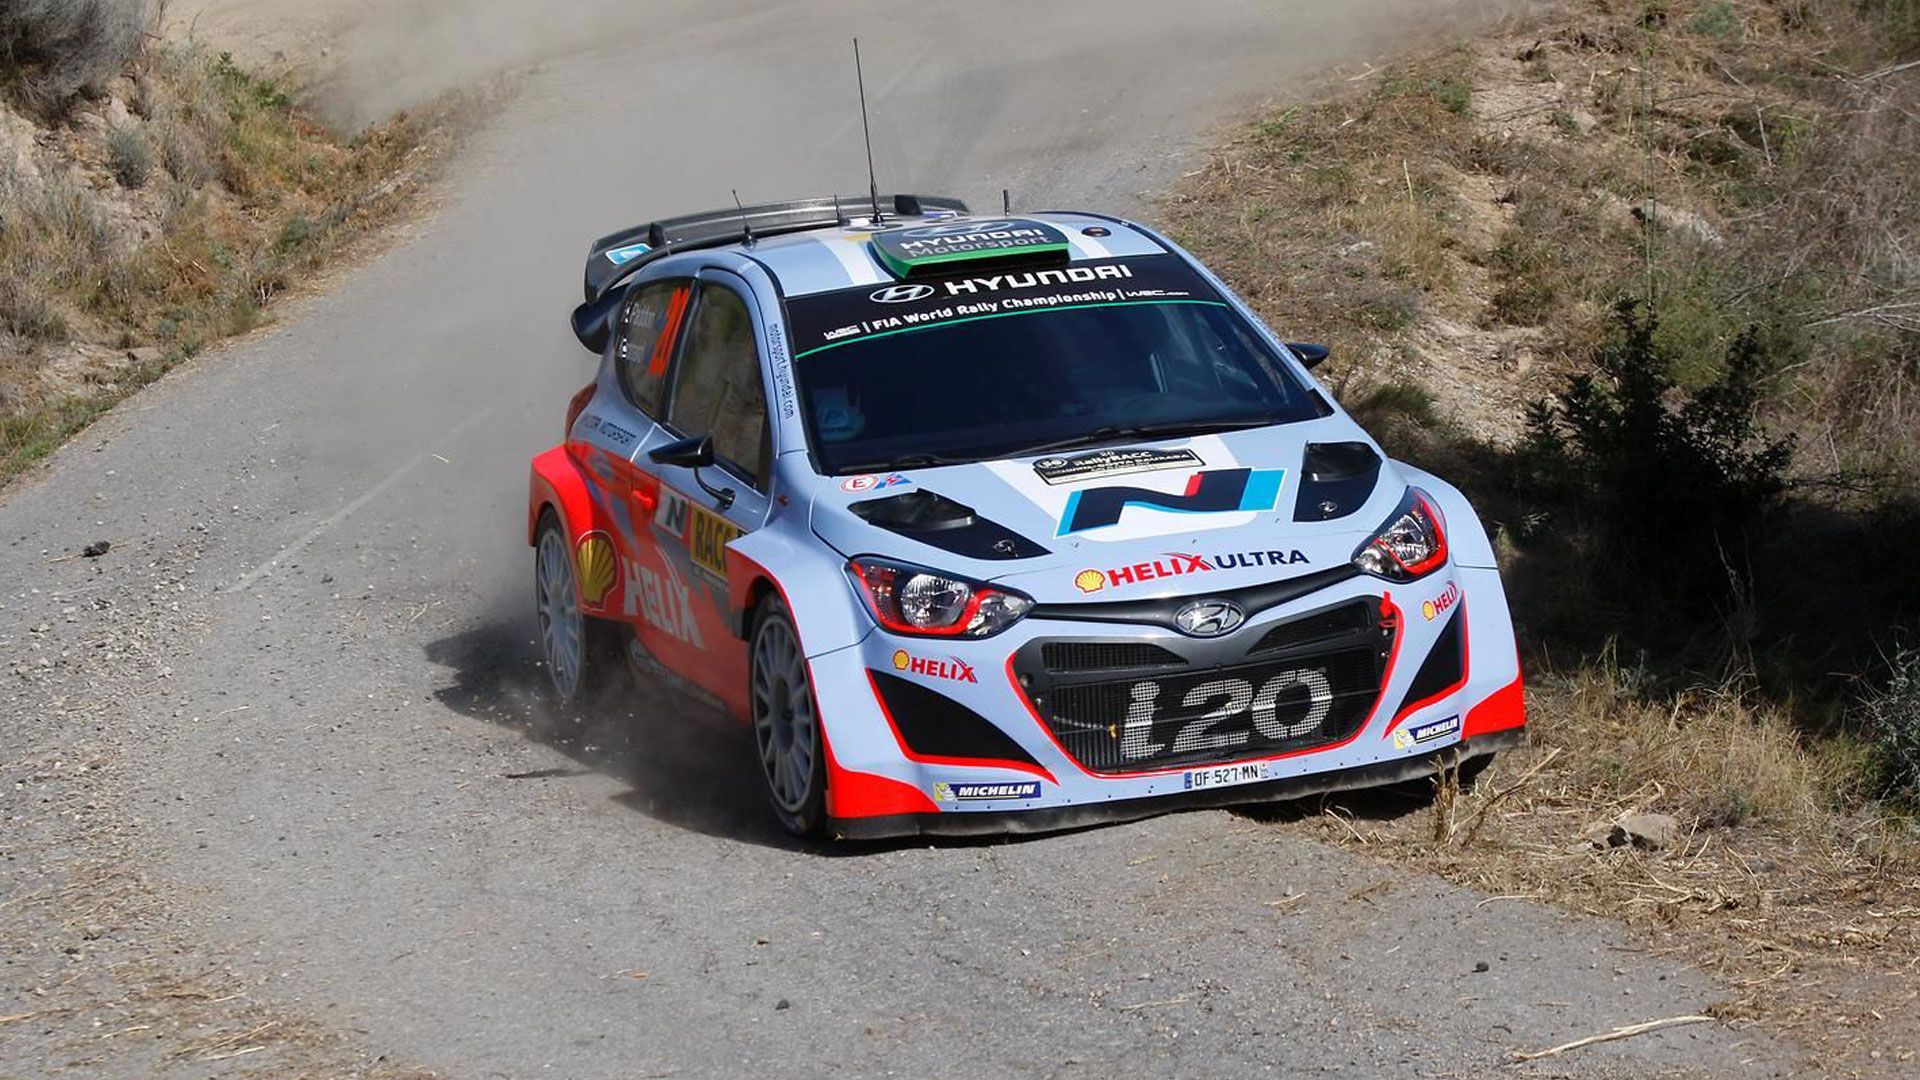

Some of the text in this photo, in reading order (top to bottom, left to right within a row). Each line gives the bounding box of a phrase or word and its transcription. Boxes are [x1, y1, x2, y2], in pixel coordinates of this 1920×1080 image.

[900, 228, 1044, 250] HYUNDAI
[908, 235, 1053, 258] Motorsport
[944, 264, 1132, 296] HYUNDAI
[872, 315, 902, 332] FIA
[905, 306, 953, 324] World
[957, 299, 999, 315] Rally
[1002, 288, 1116, 310] Championship
[1105, 549, 1311, 588] HELIX ULTRA
[621, 550, 706, 650] HELIX
[910, 655, 977, 684] HELIX
[1416, 717, 1459, 740] MICHELIN
[958, 784, 1036, 797] MICHELIN
